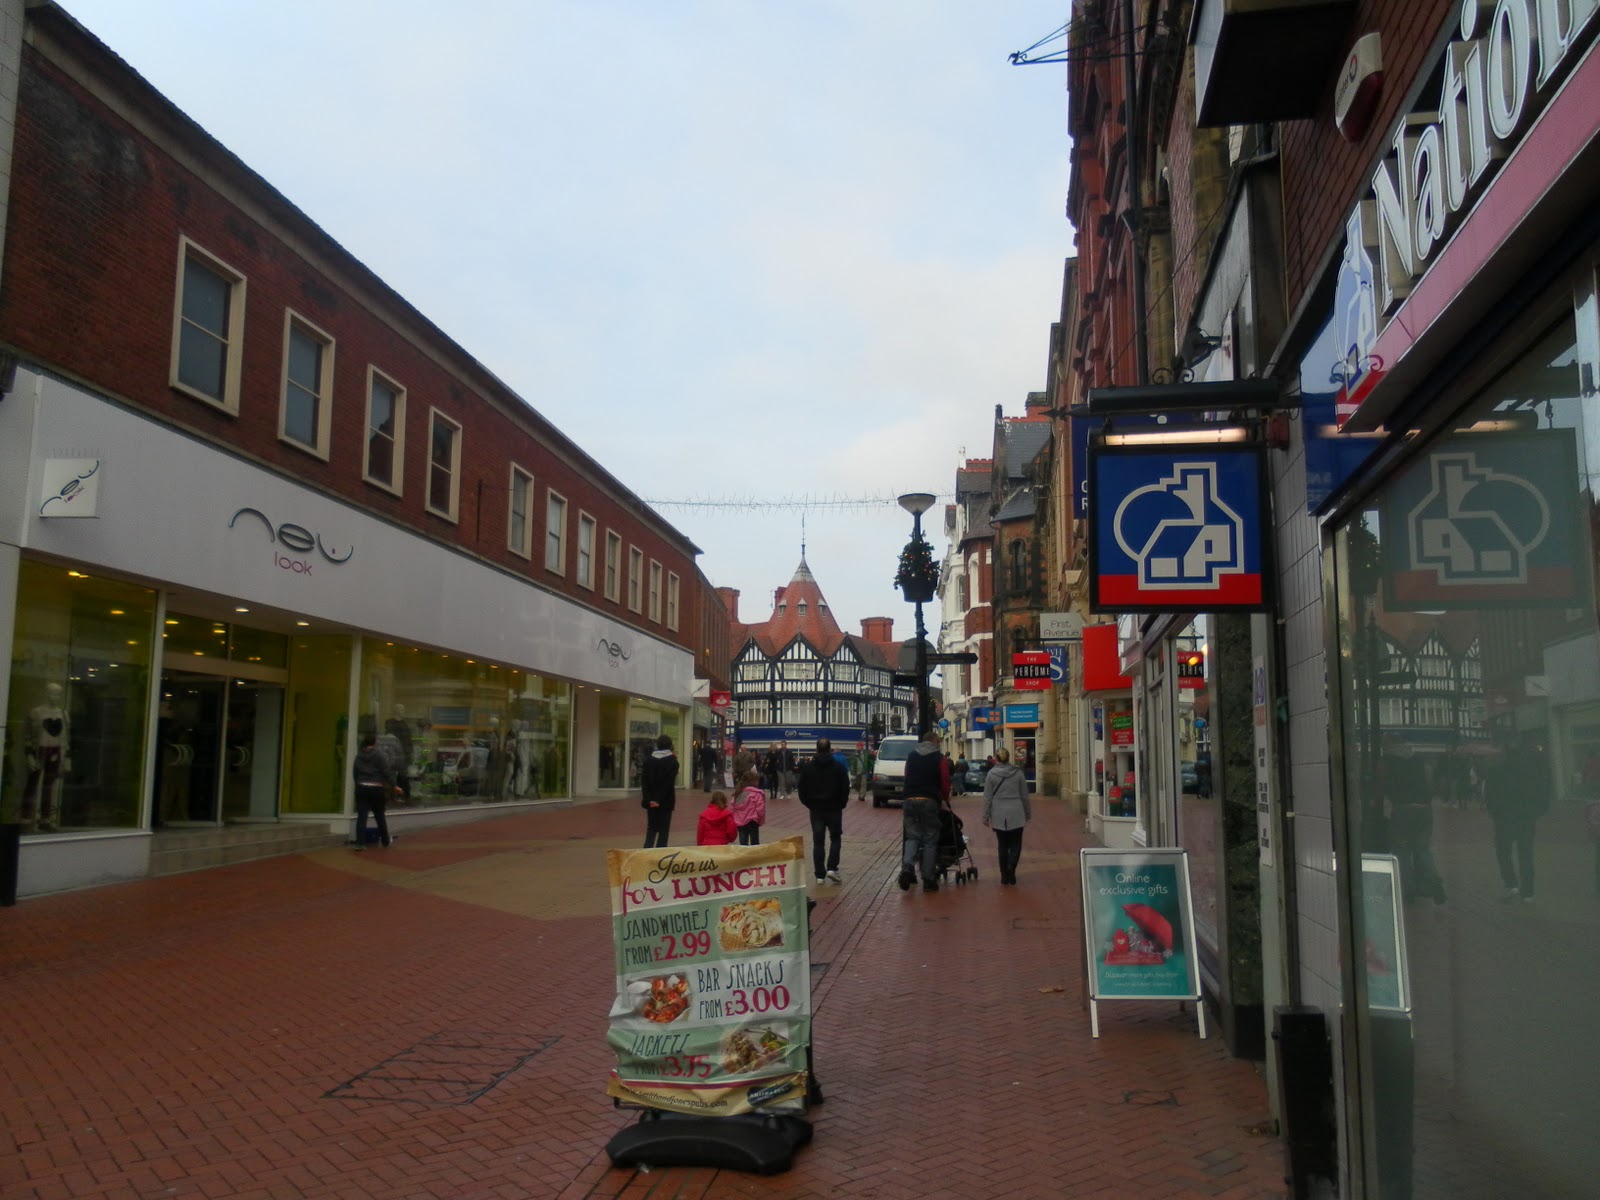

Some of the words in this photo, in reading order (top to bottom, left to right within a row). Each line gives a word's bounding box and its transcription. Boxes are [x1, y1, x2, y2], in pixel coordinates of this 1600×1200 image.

[228, 507, 354, 563] new
[273, 551, 313, 576] look
[1043, 628, 1080, 637] Avenue
[1050, 620, 1072, 629] First
[1046, 648, 1063, 656] WH
[1014, 665, 1050, 678] PERFUME
[648, 851, 696, 884] Join
[699, 857, 719, 872] us
[1115, 872, 1150, 884] Online
[620, 876, 664, 917] for
[671, 863, 788, 900] LUNCH!
[1099, 884, 1145, 895] exclusive
[1147, 884, 1168, 897] gifts
[623, 908, 710, 941] SANDWICHES
[625, 945, 653, 967] FROM
[653, 930, 712, 963] £2.99
[697, 968, 721, 993] BAR
[725, 959, 785, 990] SNACKS
[699, 997, 724, 1020] FROM
[724, 984, 791, 1018] £3.00
[627, 1032, 691, 1057] JACKETS
